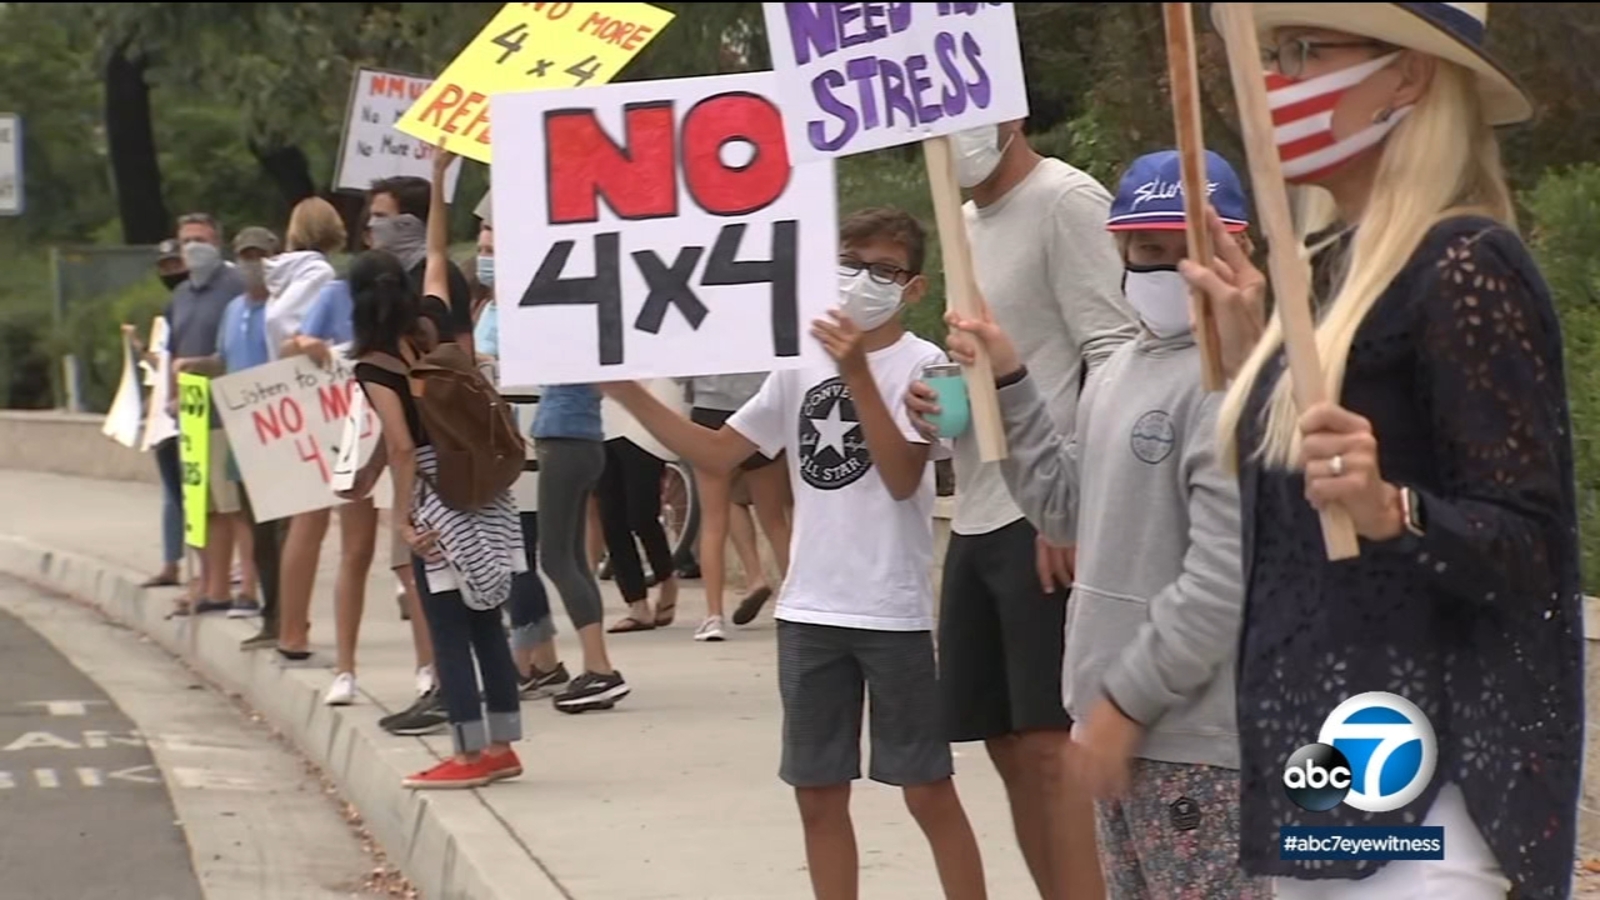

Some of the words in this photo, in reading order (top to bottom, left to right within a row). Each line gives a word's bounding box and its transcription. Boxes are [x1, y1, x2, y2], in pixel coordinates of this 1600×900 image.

[490, 22, 530, 65] 4
[577, 11, 654, 51] MORE
[784, 2, 912, 66] NEED
[806, 31, 992, 152] STRESS
[543, 90, 794, 226] NO
[518, 219, 801, 367] 4x4
[251, 396, 305, 446] NO
[821, 457, 861, 481] STAR
